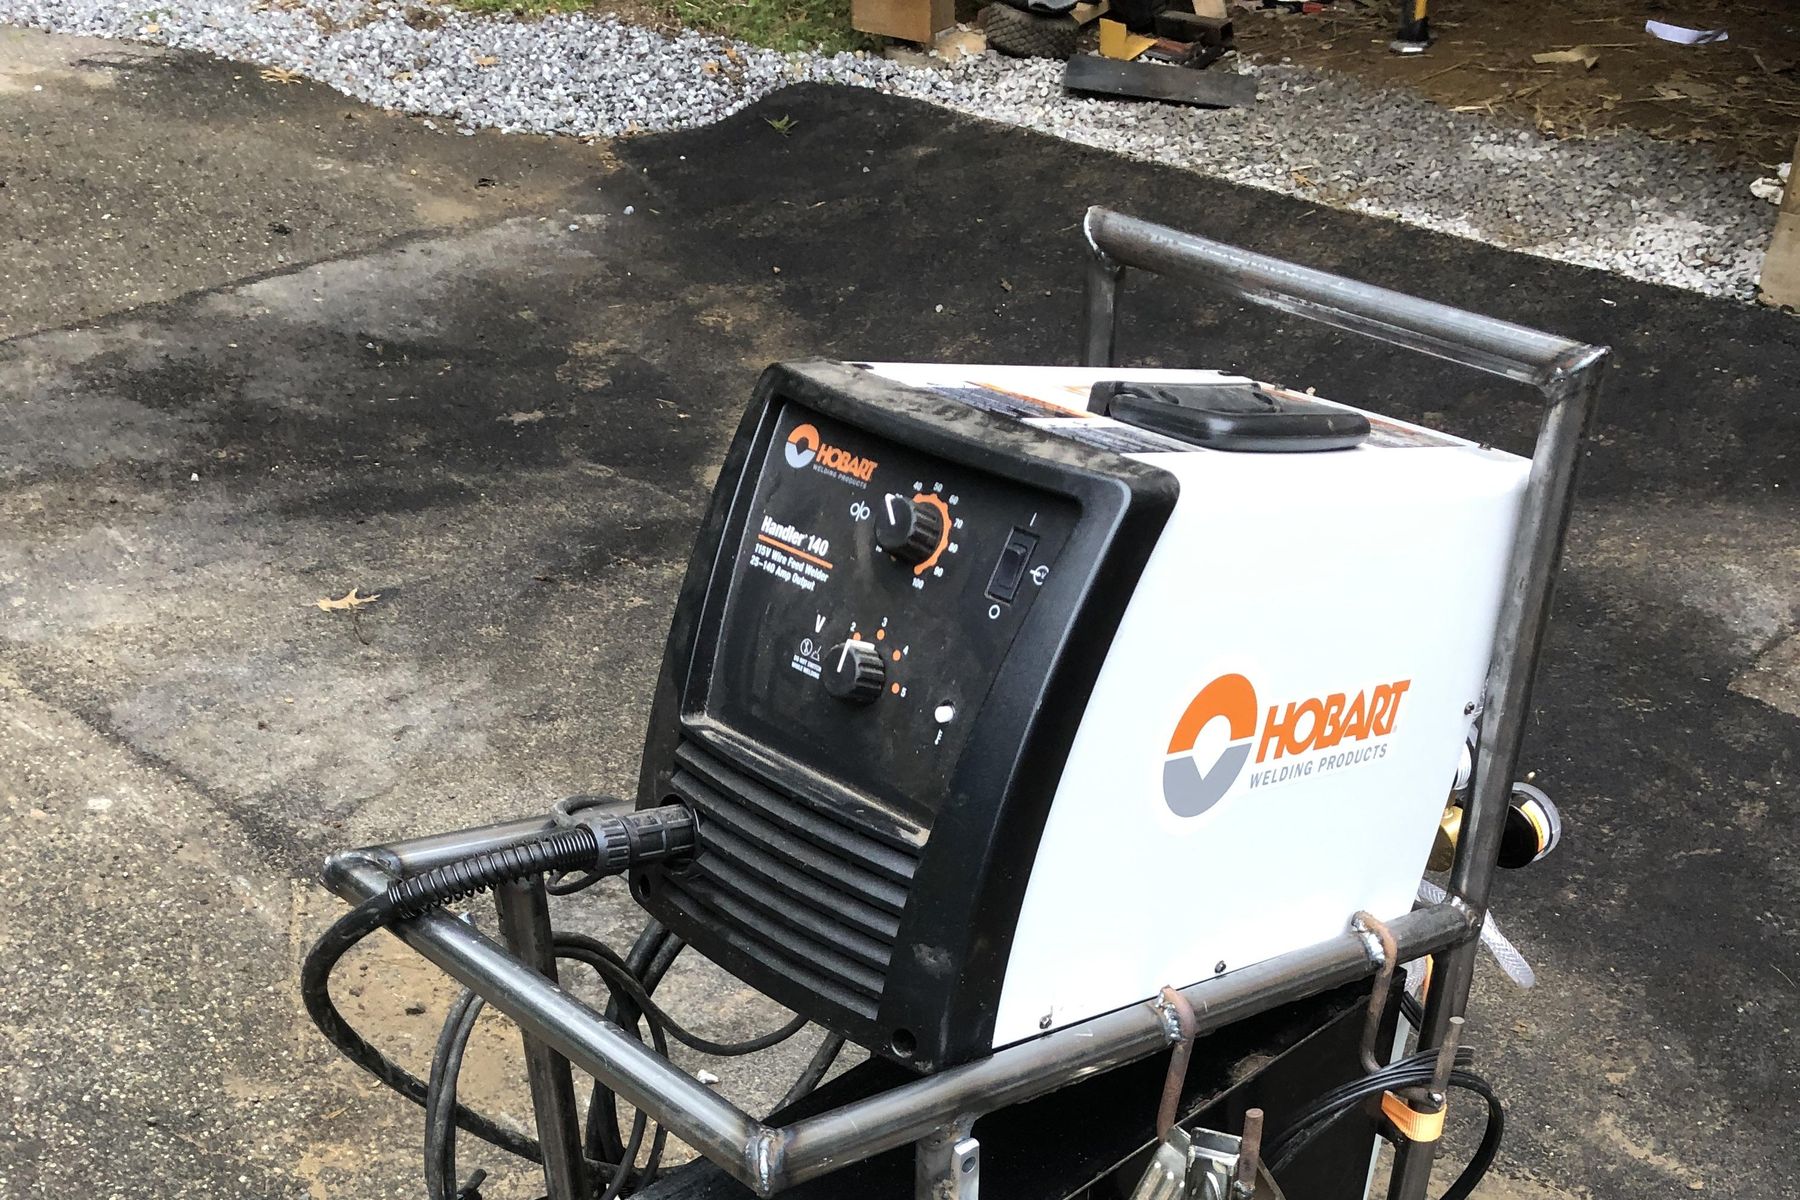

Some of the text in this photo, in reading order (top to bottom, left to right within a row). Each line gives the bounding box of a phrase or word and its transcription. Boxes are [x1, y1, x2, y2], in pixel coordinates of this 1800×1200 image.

[816, 443, 878, 481] HOBART
[813, 463, 867, 490] WELDING PRODUCTS
[913, 481, 923, 491] 40
[933, 481, 943, 492] 50
[953, 518, 964, 529] 70
[761, 515, 829, 557] Handler 140
[754, 543, 829, 582] 115V Wire Feed Welder
[774, 565, 792, 582] Amp
[791, 572, 816, 591] Output
[912, 577, 924, 589] 100
[815, 614, 826, 633] V
[850, 621, 857, 632] 2
[881, 616, 888, 628] 3
[903, 645, 909, 656] 4
[900, 686, 907, 698] 5
[1255, 679, 1411, 764] HOBART
[1250, 743, 1388, 789] WELDING PRODUCTS
